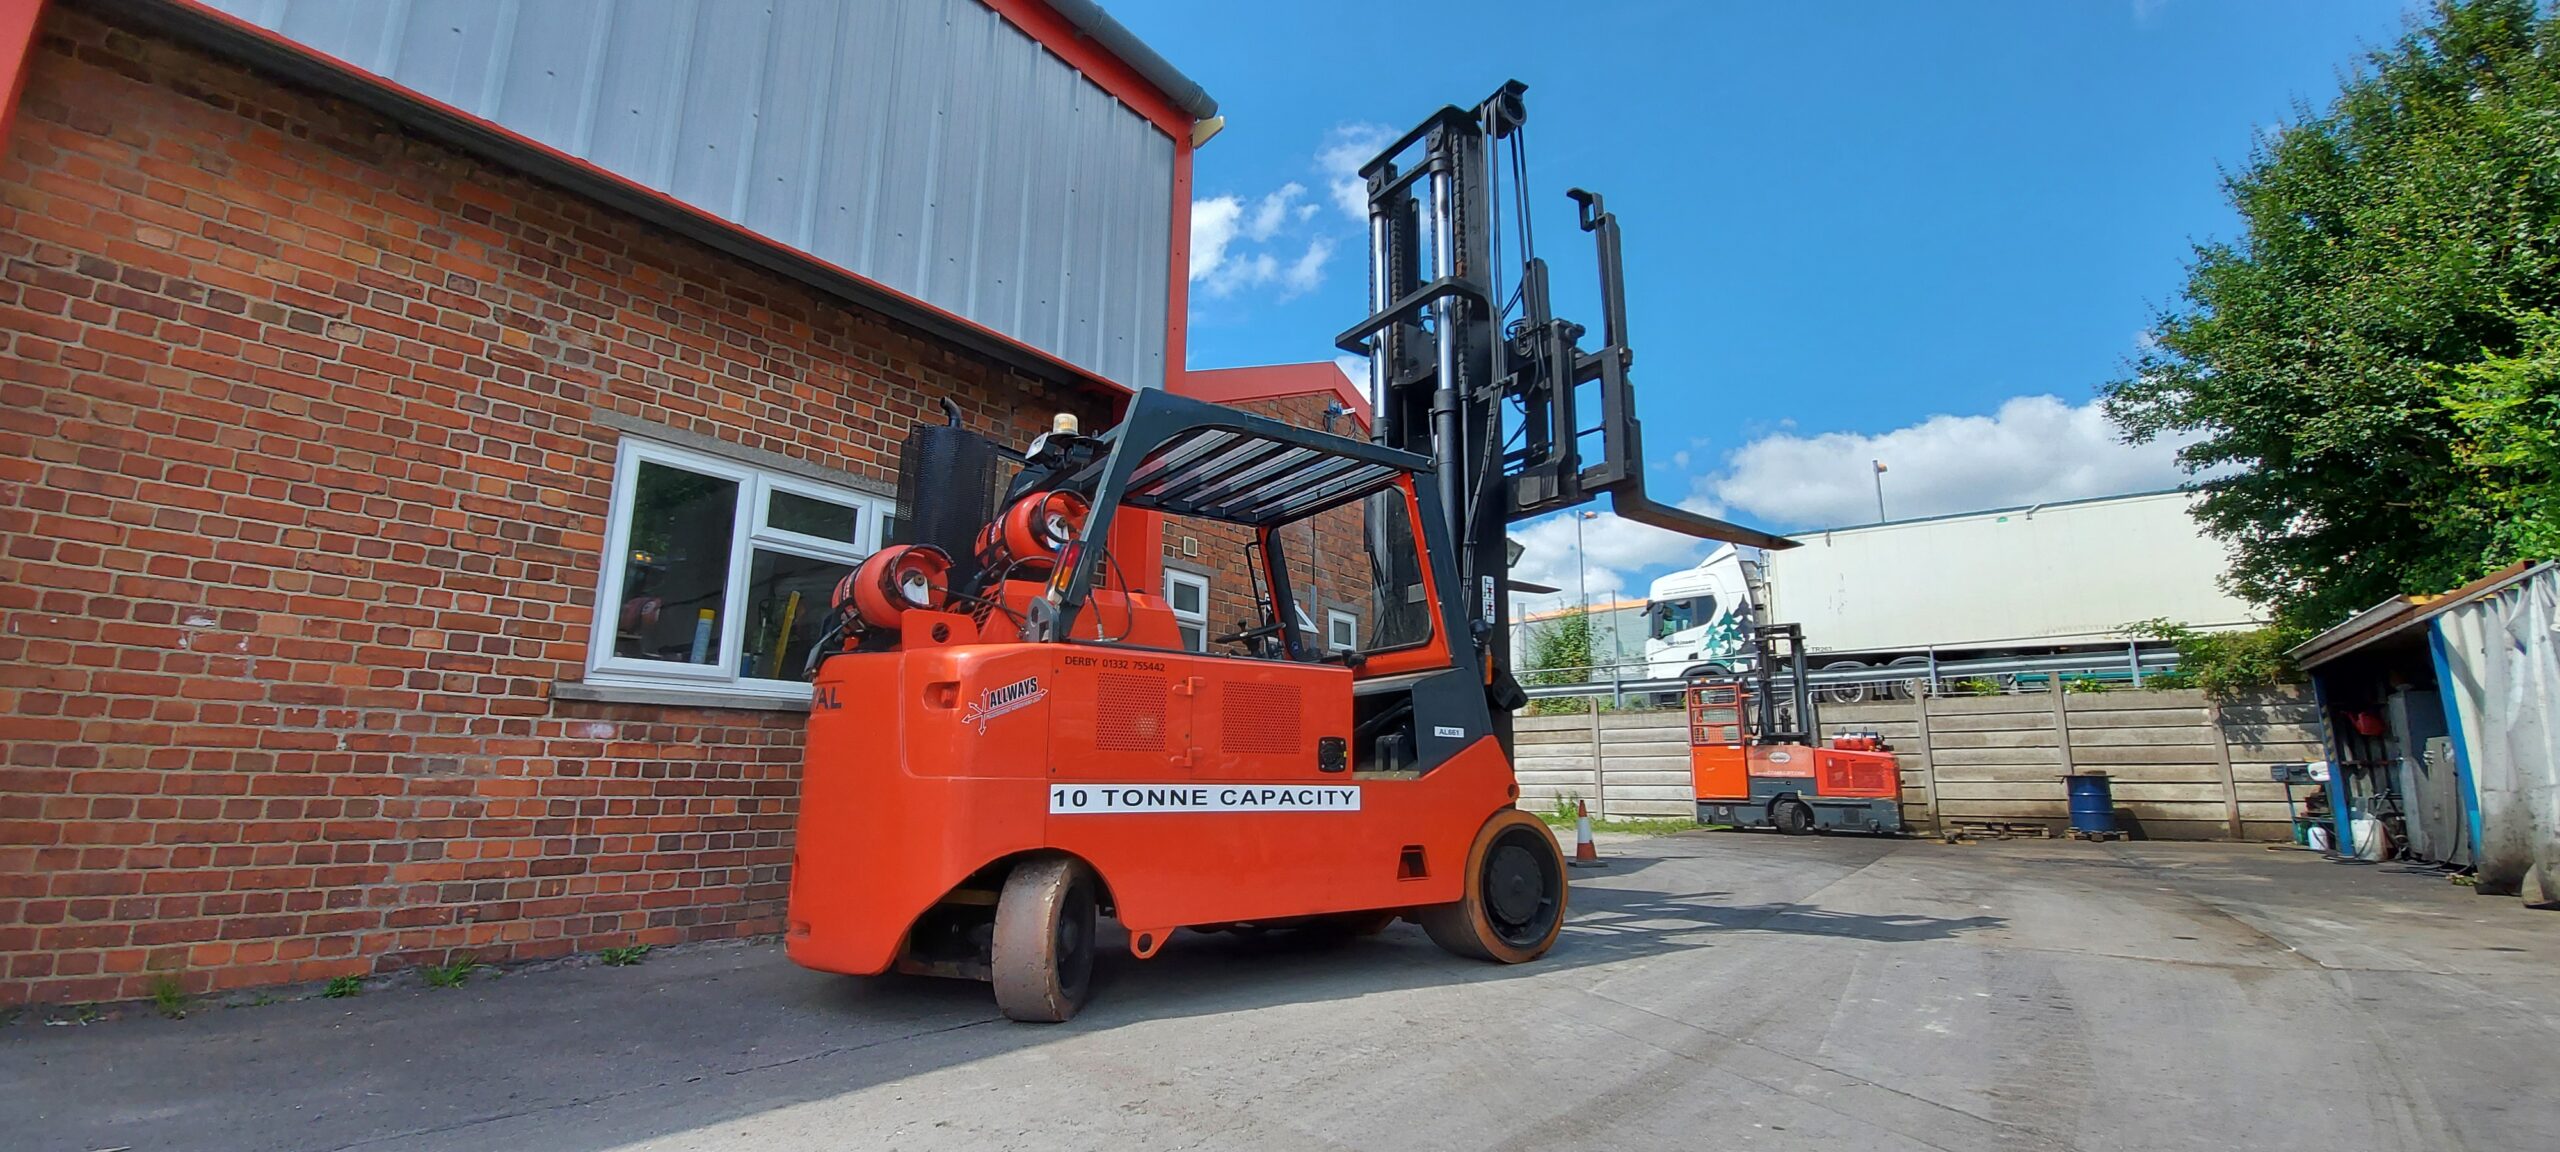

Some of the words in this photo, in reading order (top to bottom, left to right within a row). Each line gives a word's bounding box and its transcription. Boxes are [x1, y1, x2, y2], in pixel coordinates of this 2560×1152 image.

[1064, 656, 1098, 667] DERBY
[1102, 659, 1129, 670] 01332
[1132, 661, 1166, 672] 755442
[989, 677, 1038, 708] ALLWAYS
[1053, 789, 1088, 808] 10
[1101, 789, 1208, 808] TONNE
[1219, 789, 1355, 806] CAPACITY
